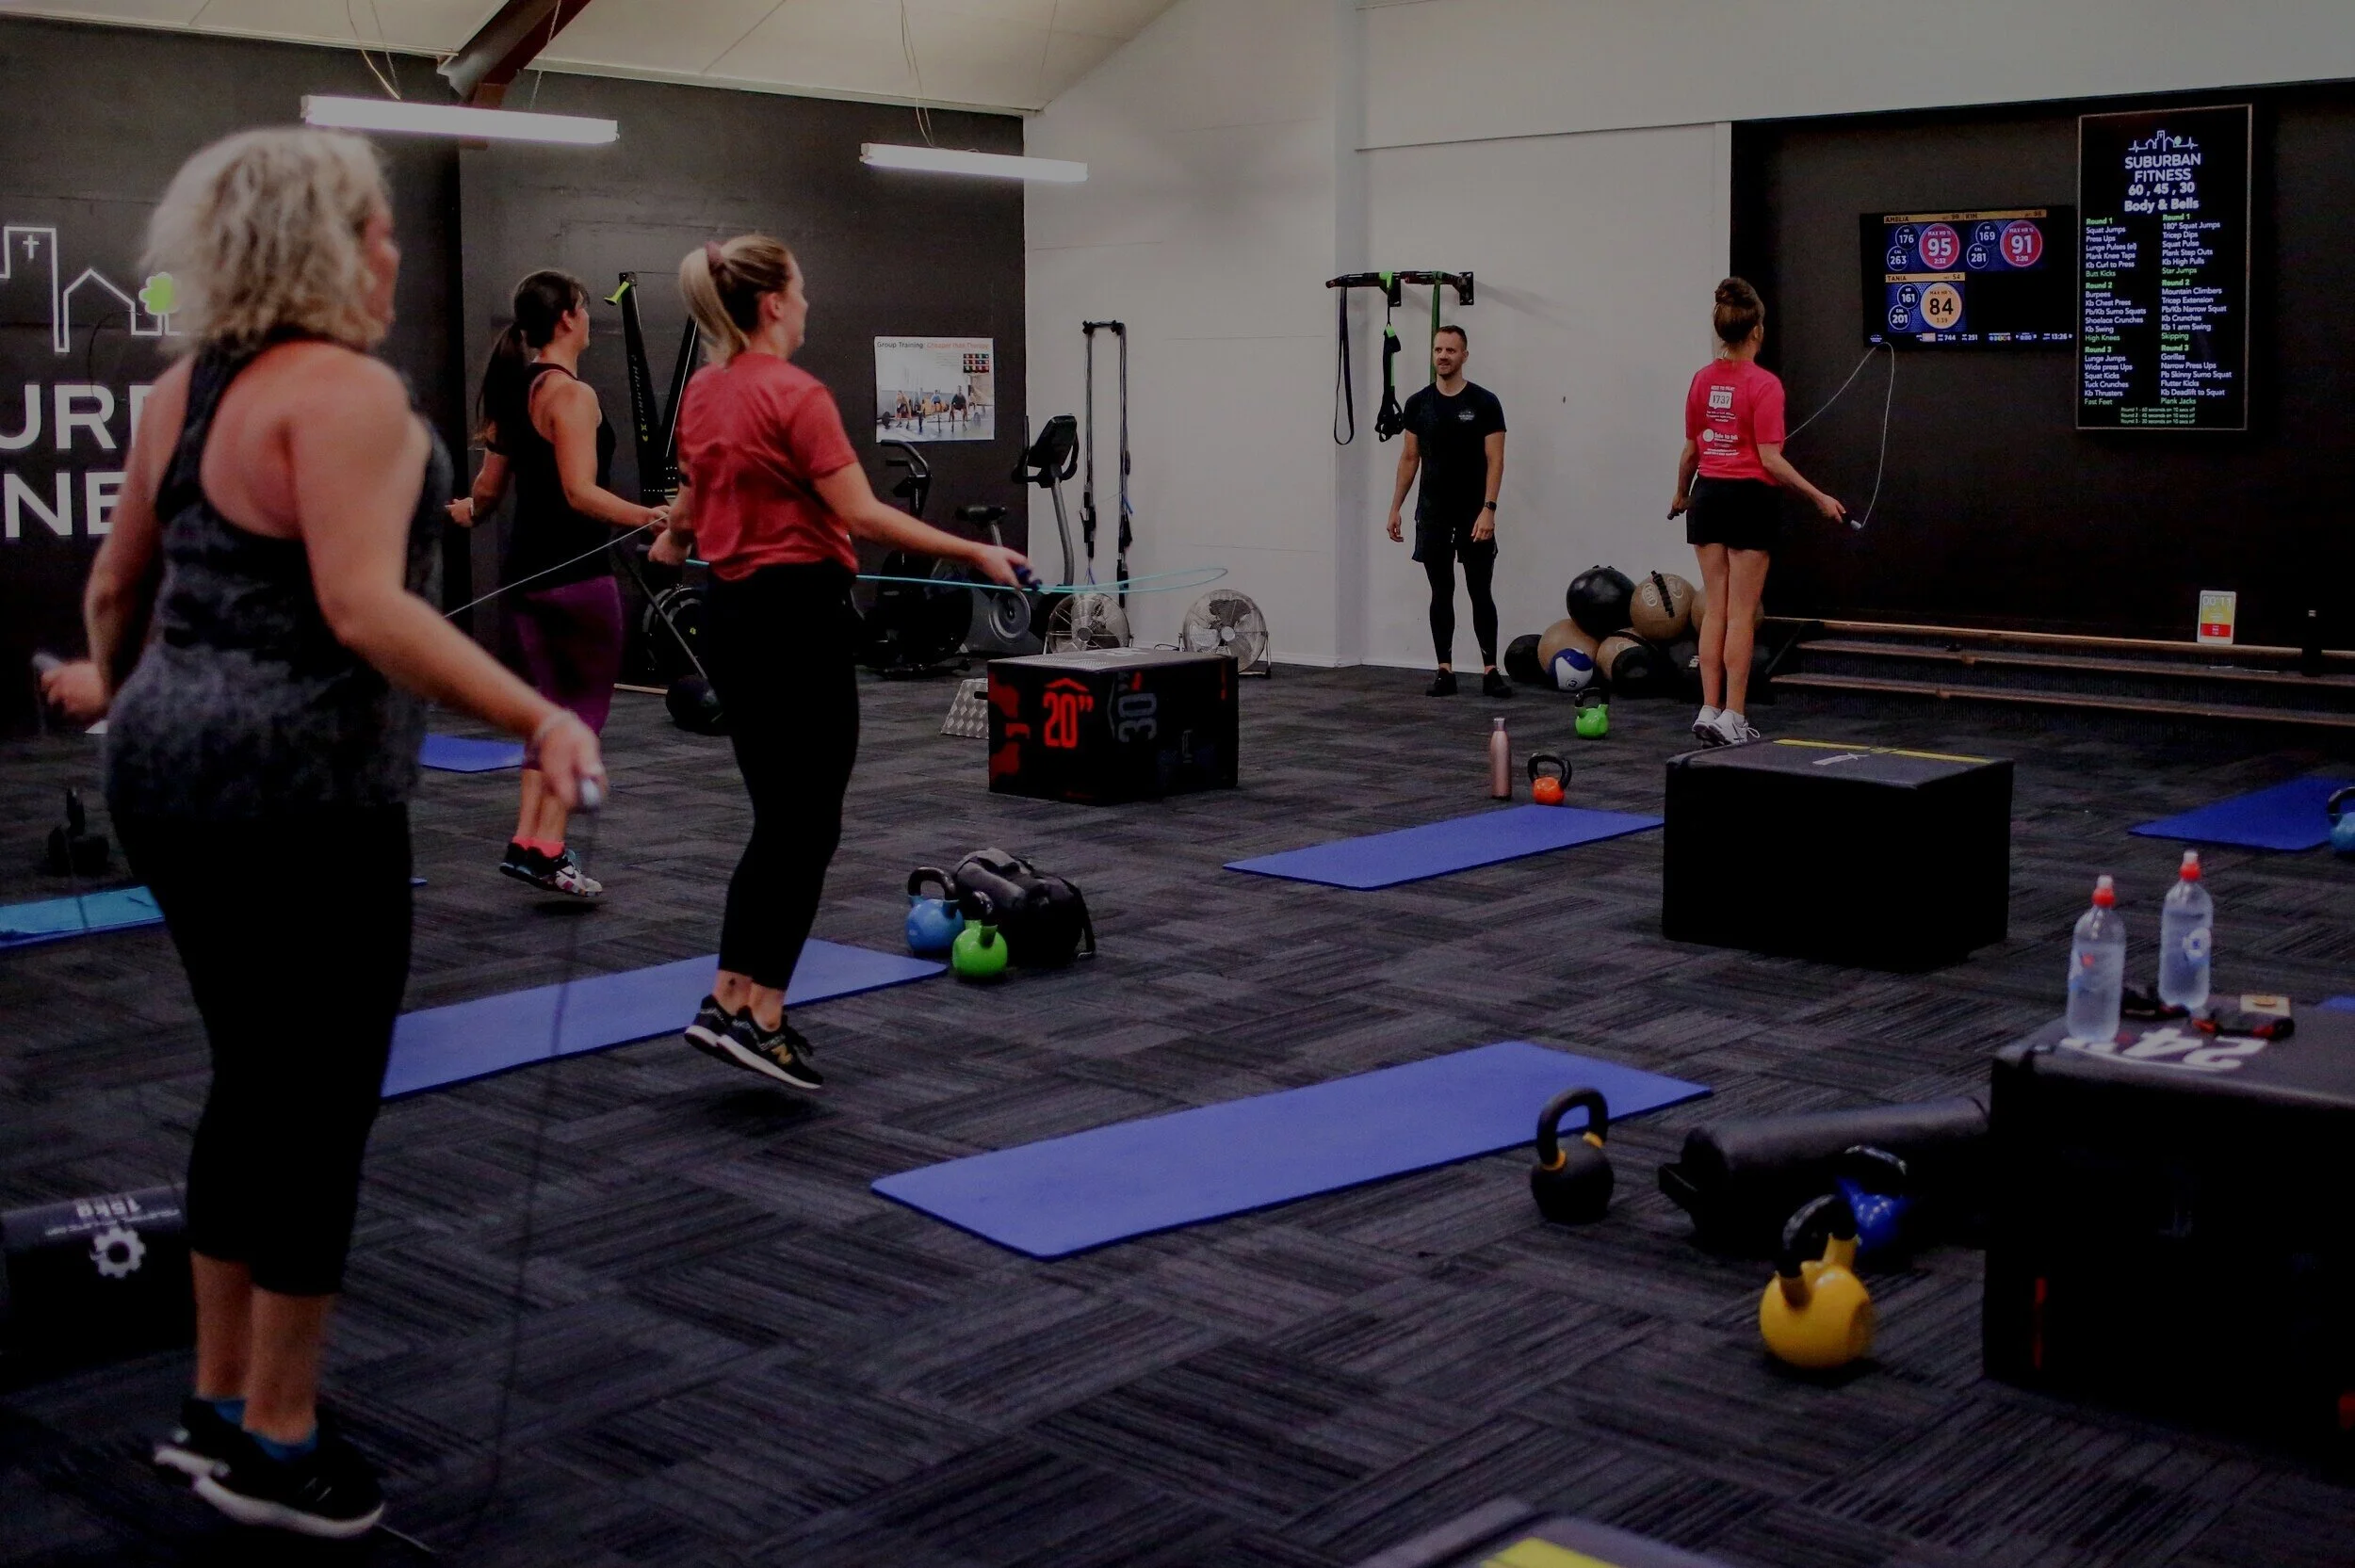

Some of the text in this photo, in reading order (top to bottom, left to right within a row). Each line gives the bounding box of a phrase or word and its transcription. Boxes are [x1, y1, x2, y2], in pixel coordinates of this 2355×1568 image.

[2124, 153, 2201, 169] SUBURBAN
[2135, 169, 2192, 183] FITNESS
[2128, 182, 2196, 196] 60 45 30
[2124, 197, 2200, 214] Body & Bells
[2104, 226, 2126, 234] Jumps
[2178, 222, 2198, 231] Squat
[1899, 234, 1914, 243] 176
[1979, 232, 1996, 241] 169
[2162, 231, 2199, 240] Tricep Dips
[1927, 237, 1952, 256] 95
[2010, 234, 2032, 254] 91
[1971, 252, 1987, 263] 281
[2121, 251, 2136, 260] Taps
[2180, 249, 2196, 257] Step
[1890, 256, 1907, 265] 263
[2172, 258, 2188, 267] High
[1902, 294, 1915, 303] 161
[2161, 297, 2182, 305] Tricep
[1929, 298, 1954, 315] 84
[2207, 305, 2227, 314] Squat
[1892, 315, 1908, 324] 201
[2191, 323, 2212, 331] Swing
[2086, 334, 2100, 343] High
[2161, 332, 2189, 341] Skipping
[2085, 355, 2104, 364] Lunge
[2120, 364, 2133, 372] Ups
[2203, 362, 2217, 370] Ups
[2084, 372, 2103, 380] Squat
[2170, 371, 2192, 380] Skinny
[2212, 371, 2233, 380] Squat
[2206, 388, 2226, 397] Squat
[1713, 396, 1730, 405] 1737
